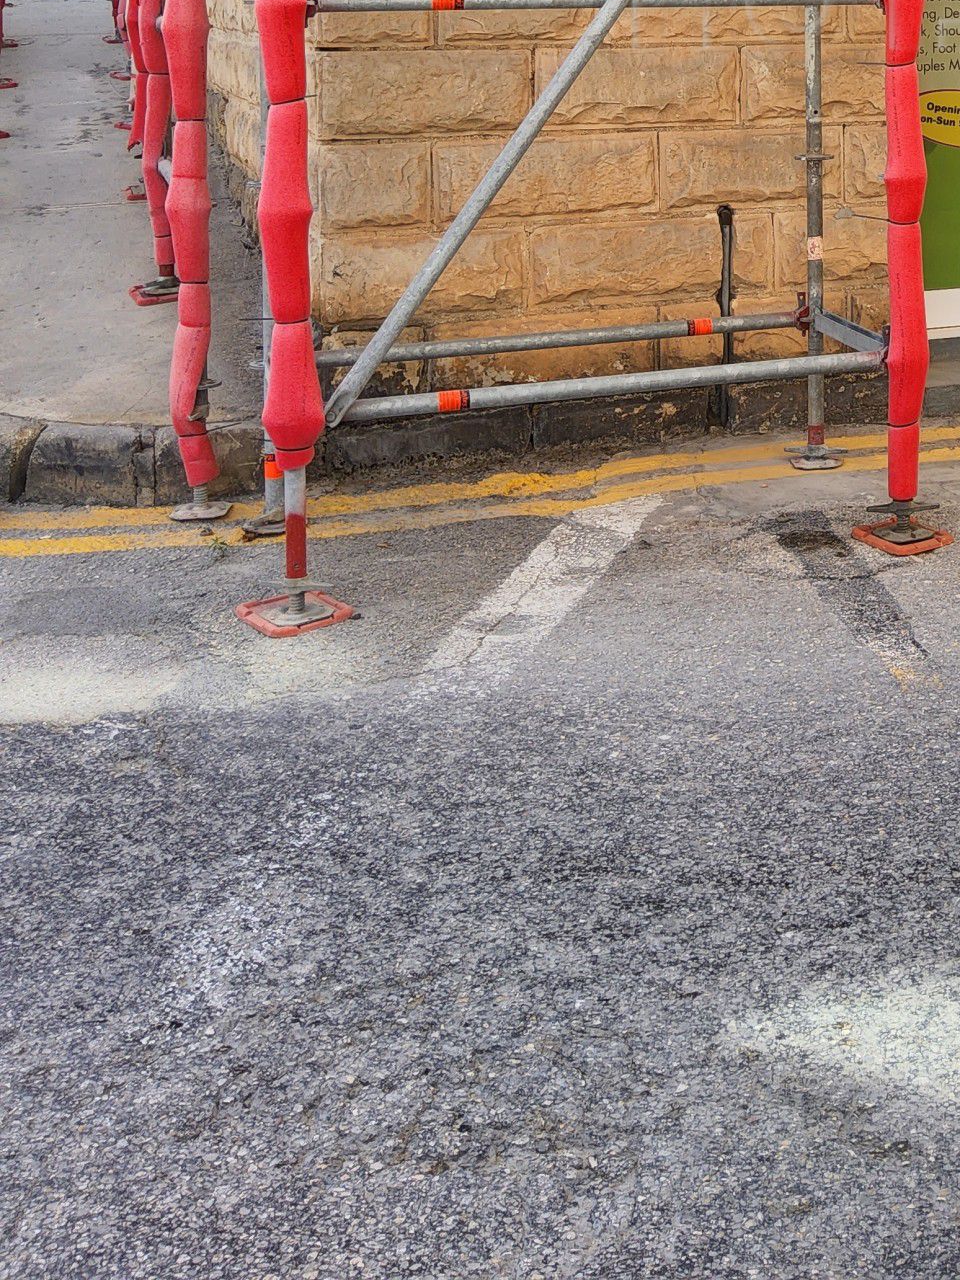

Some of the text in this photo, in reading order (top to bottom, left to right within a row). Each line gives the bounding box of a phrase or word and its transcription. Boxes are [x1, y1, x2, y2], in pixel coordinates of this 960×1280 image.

[932, 41, 957, 54] Foot
[917, 59, 946, 75] uples
[920, 115, 956, 128] on-Sun
